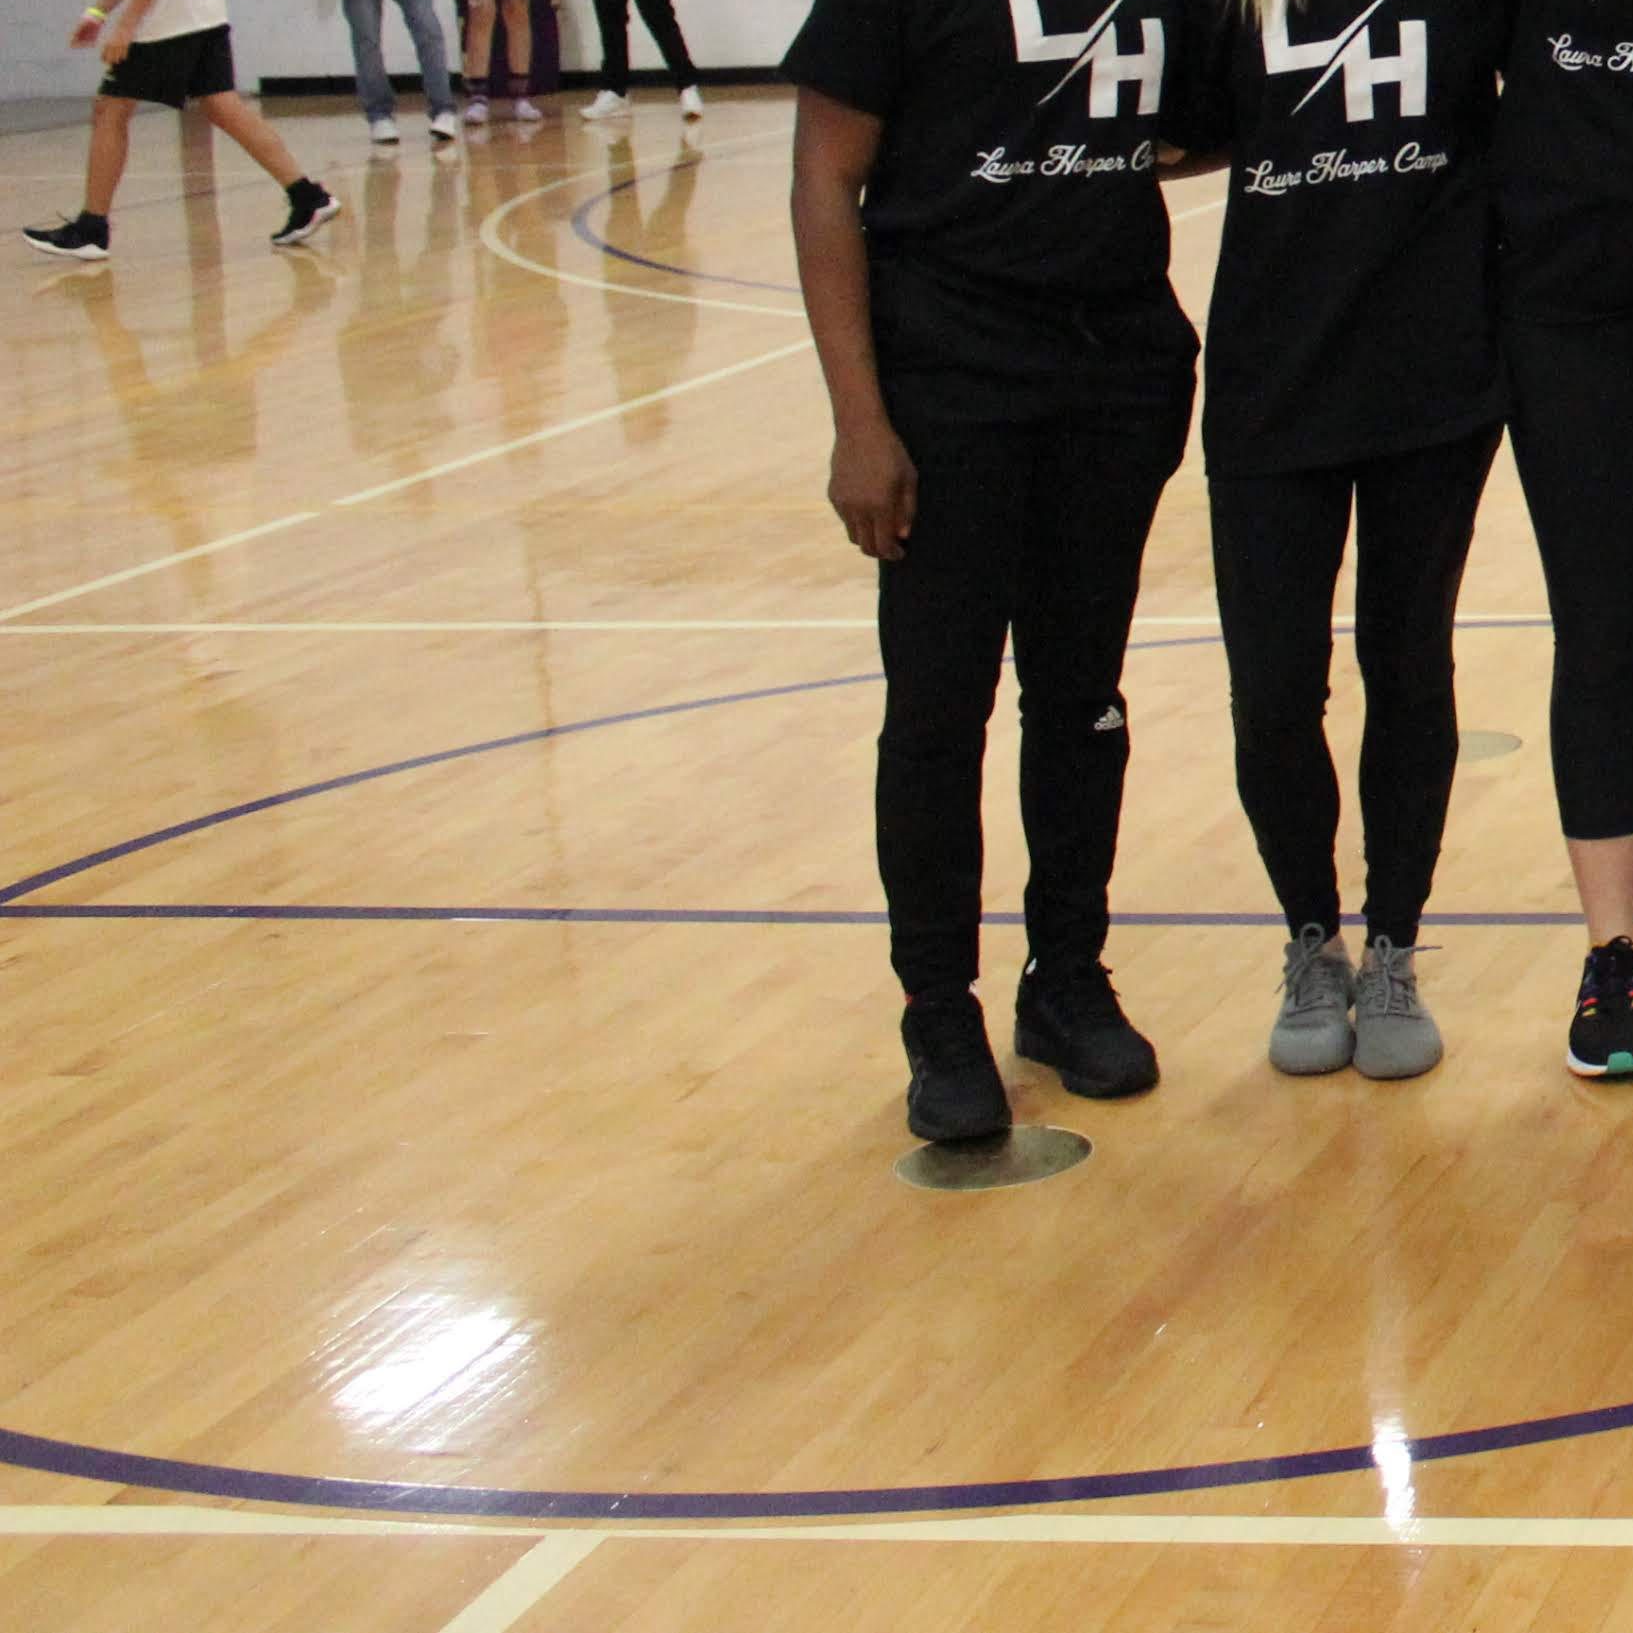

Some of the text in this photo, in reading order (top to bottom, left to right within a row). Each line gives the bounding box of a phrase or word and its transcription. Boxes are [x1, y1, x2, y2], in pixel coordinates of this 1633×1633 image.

[1547, 33, 1603, 70] Laura
[970, 146, 1036, 183] Laura
[1040, 144, 1127, 178] Harper
[1244, 142, 1449, 195] Laura Harper Camps
